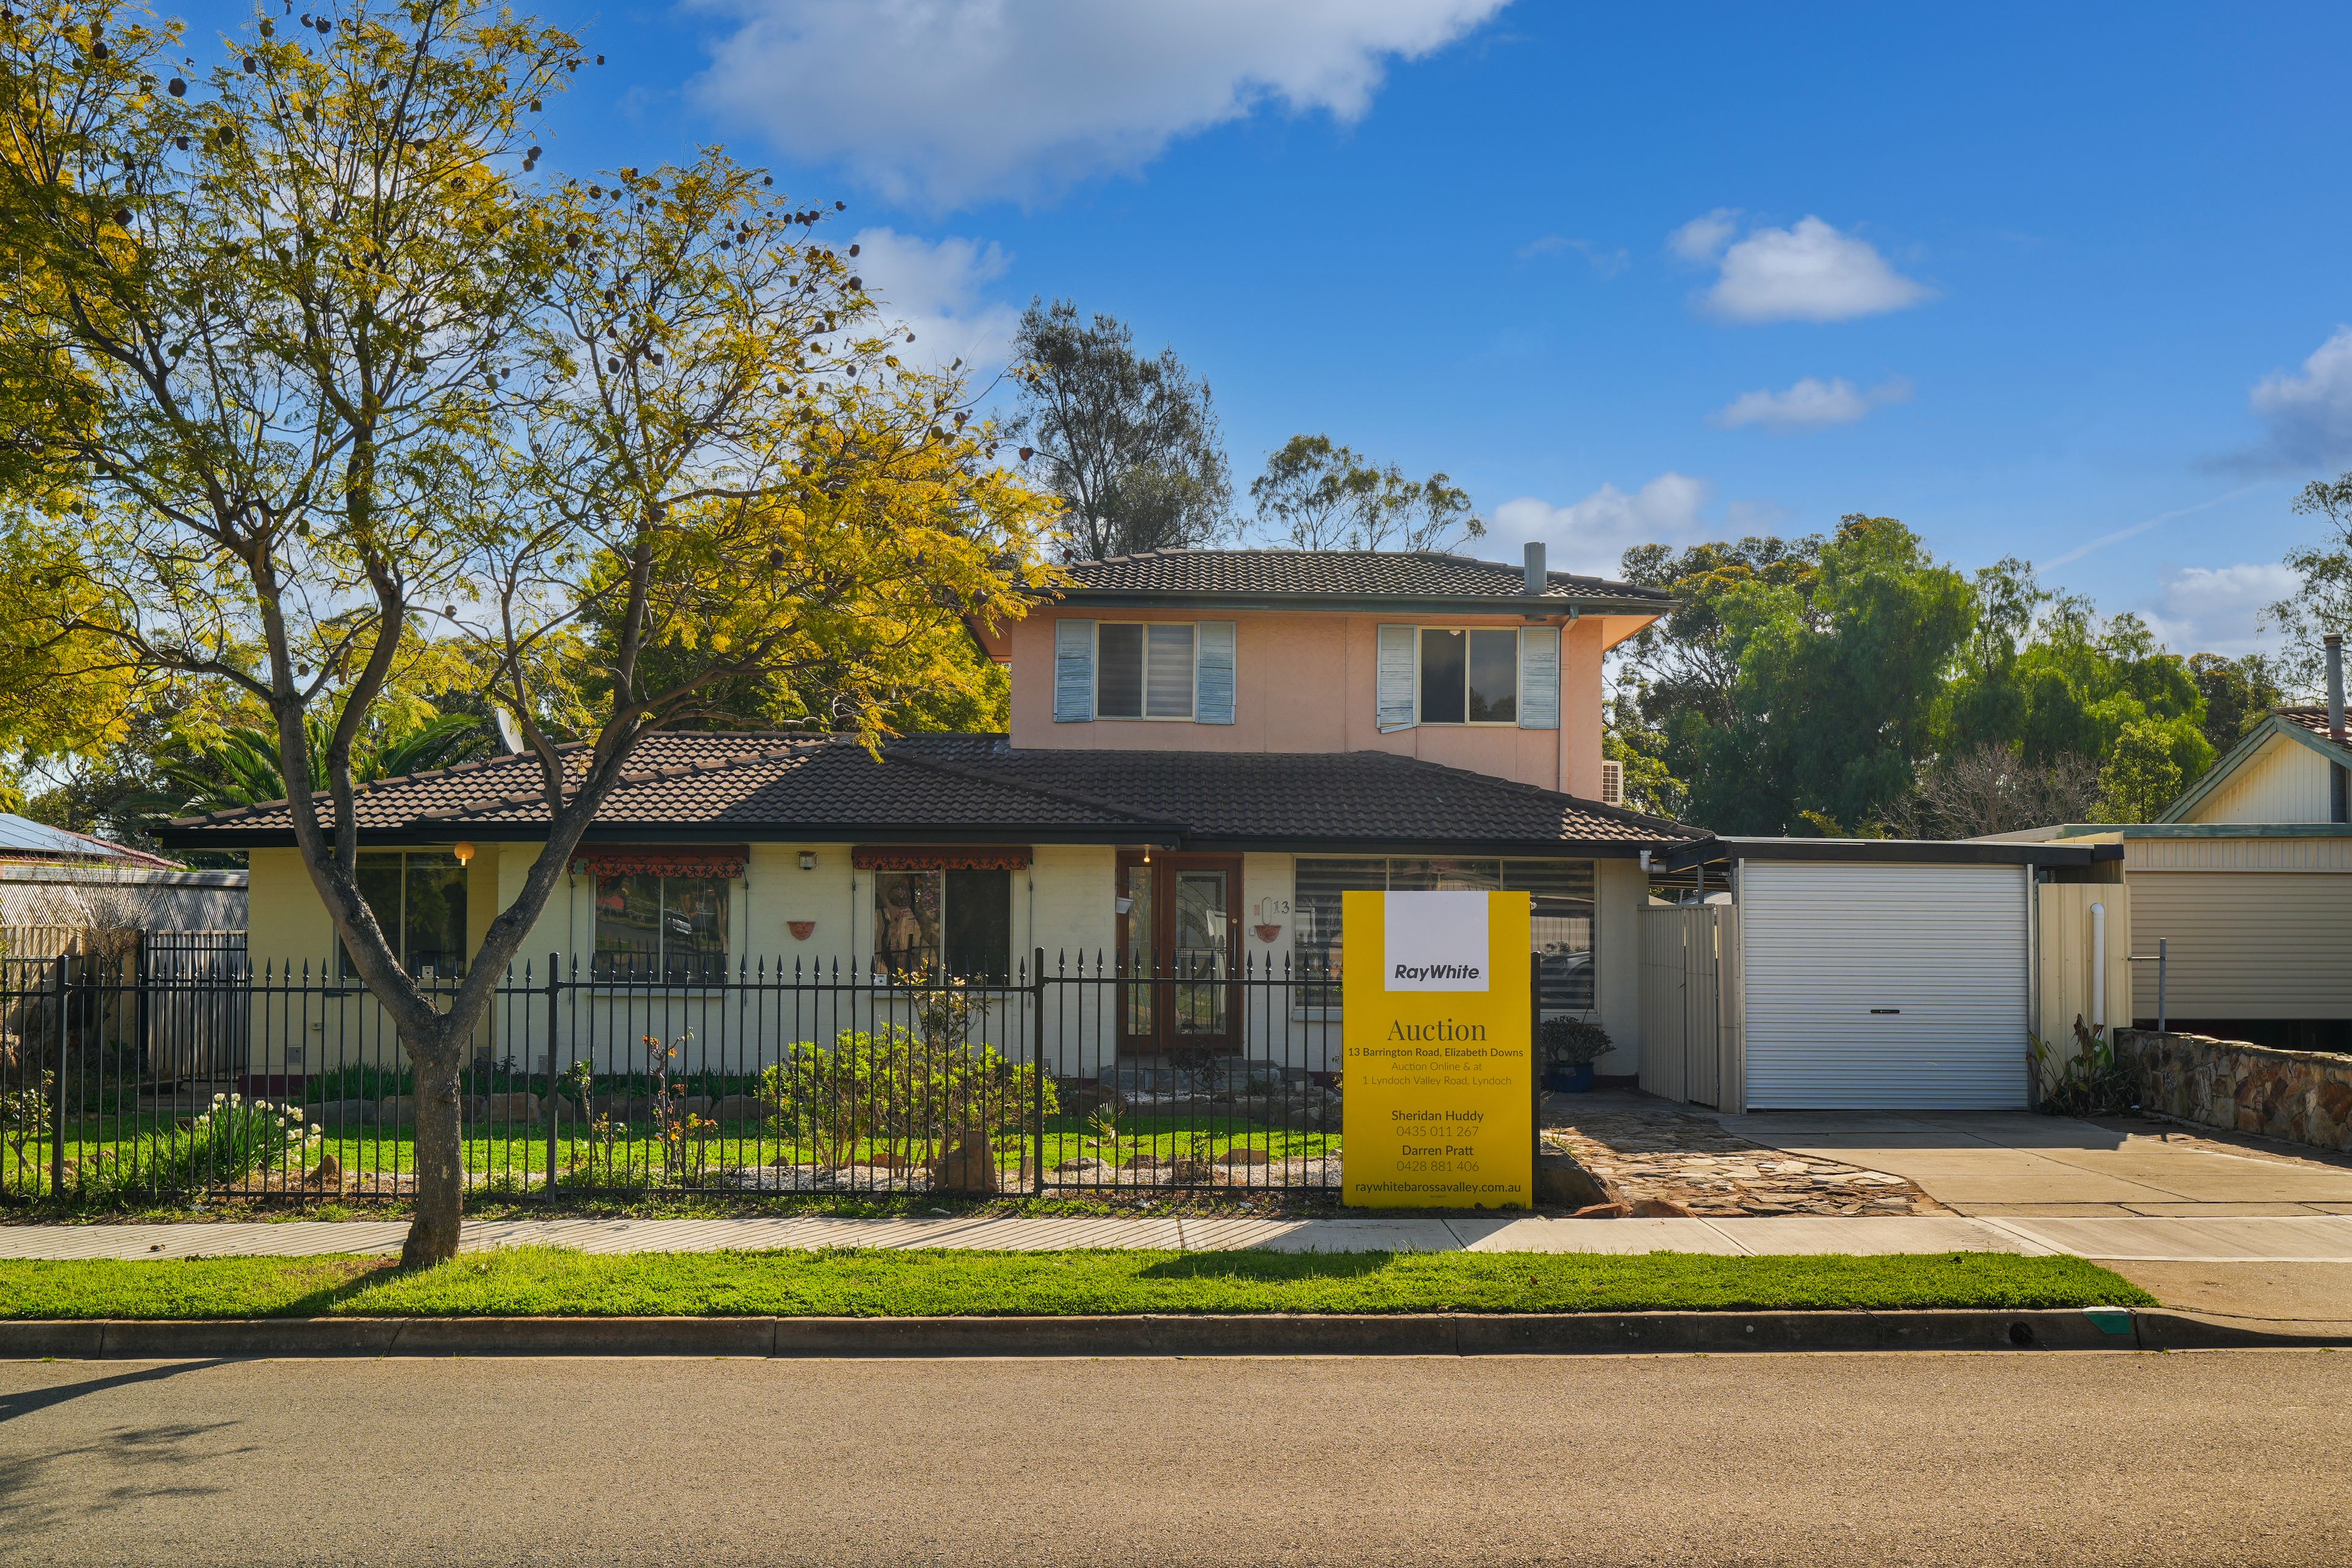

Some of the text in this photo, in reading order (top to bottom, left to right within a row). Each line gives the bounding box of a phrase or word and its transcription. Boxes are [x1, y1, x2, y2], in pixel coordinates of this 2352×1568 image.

[1274, 901, 1289, 914] 13
[1387, 1018, 1487, 1041] Auction
[1348, 1047, 1524, 1058] 13 Barrington Road, Elizabeth Downs
[1391, 1061, 1483, 1071] Auction Online & at
[1363, 1076, 1512, 1087] 1 Lyndoch Valley Road, Lyndoch
[1391, 1110, 1484, 1123] Sheridan Huddy
[1396, 1126, 1479, 1137] 0435 011 267
[1402, 1145, 1474, 1156] Darren Pratt
[1396, 1161, 1480, 1172] 0428 881 406
[1355, 1182, 1521, 1194] raywhitebarossavalley.com.au
